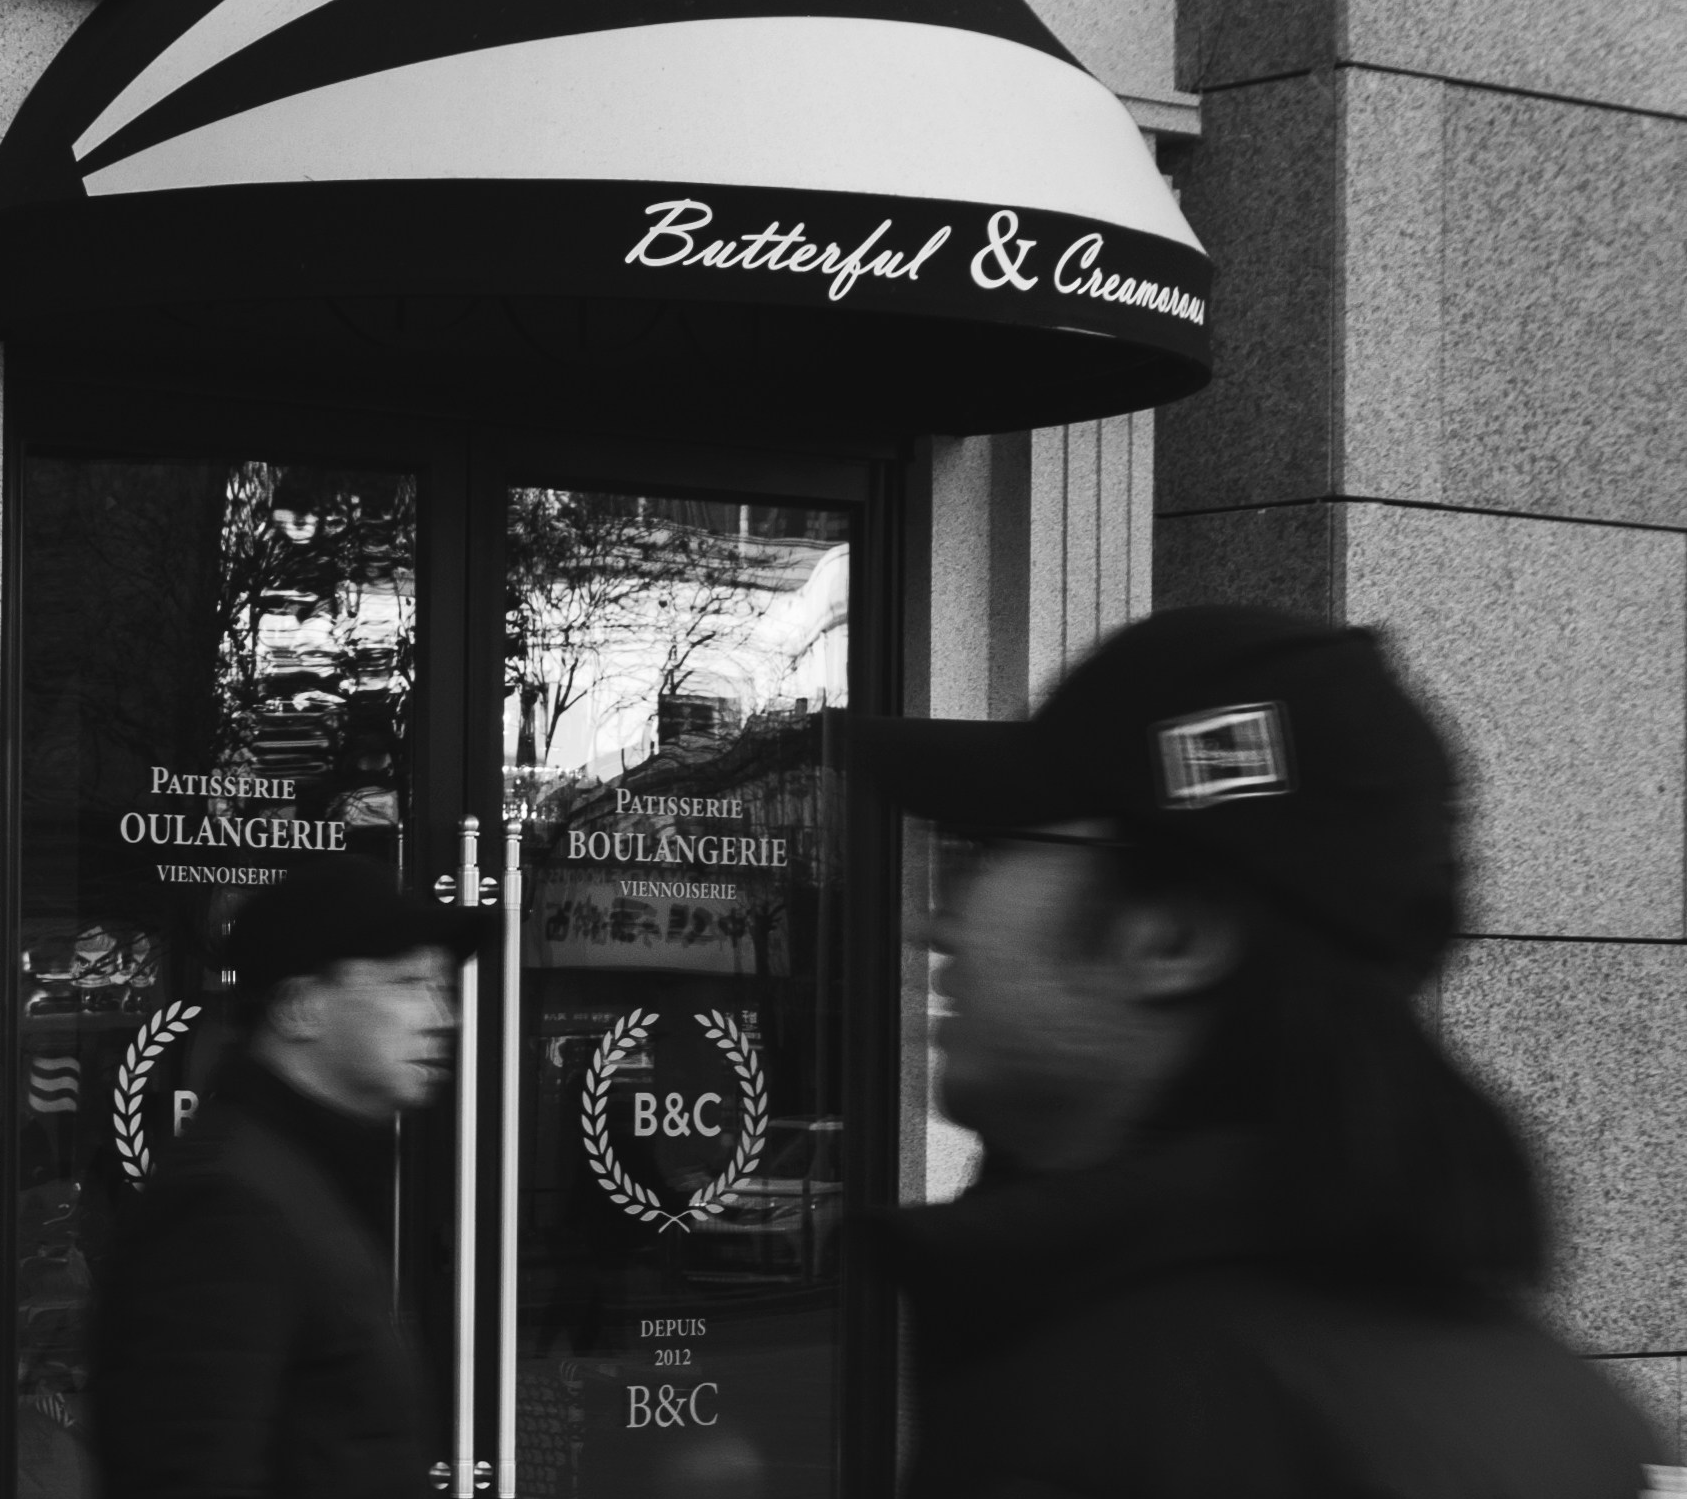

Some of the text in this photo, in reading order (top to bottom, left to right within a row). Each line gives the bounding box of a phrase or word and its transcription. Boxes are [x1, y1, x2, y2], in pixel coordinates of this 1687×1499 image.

[624, 198, 952, 301] Butterful
[969, 209, 1039, 291] &
[150, 766, 296, 799] PATISSERIE
[615, 787, 743, 819] PATISSERIE
[120, 811, 348, 851] OULANGERIE
[567, 830, 789, 867] BOULANGERIE
[619, 880, 737, 900] VIENNOISERIE
[633, 1090, 723, 1138] B&C
[640, 1318, 706, 1338] DEPUIS
[654, 1348, 692, 1366] 2012
[625, 1382, 719, 1428] B&C
